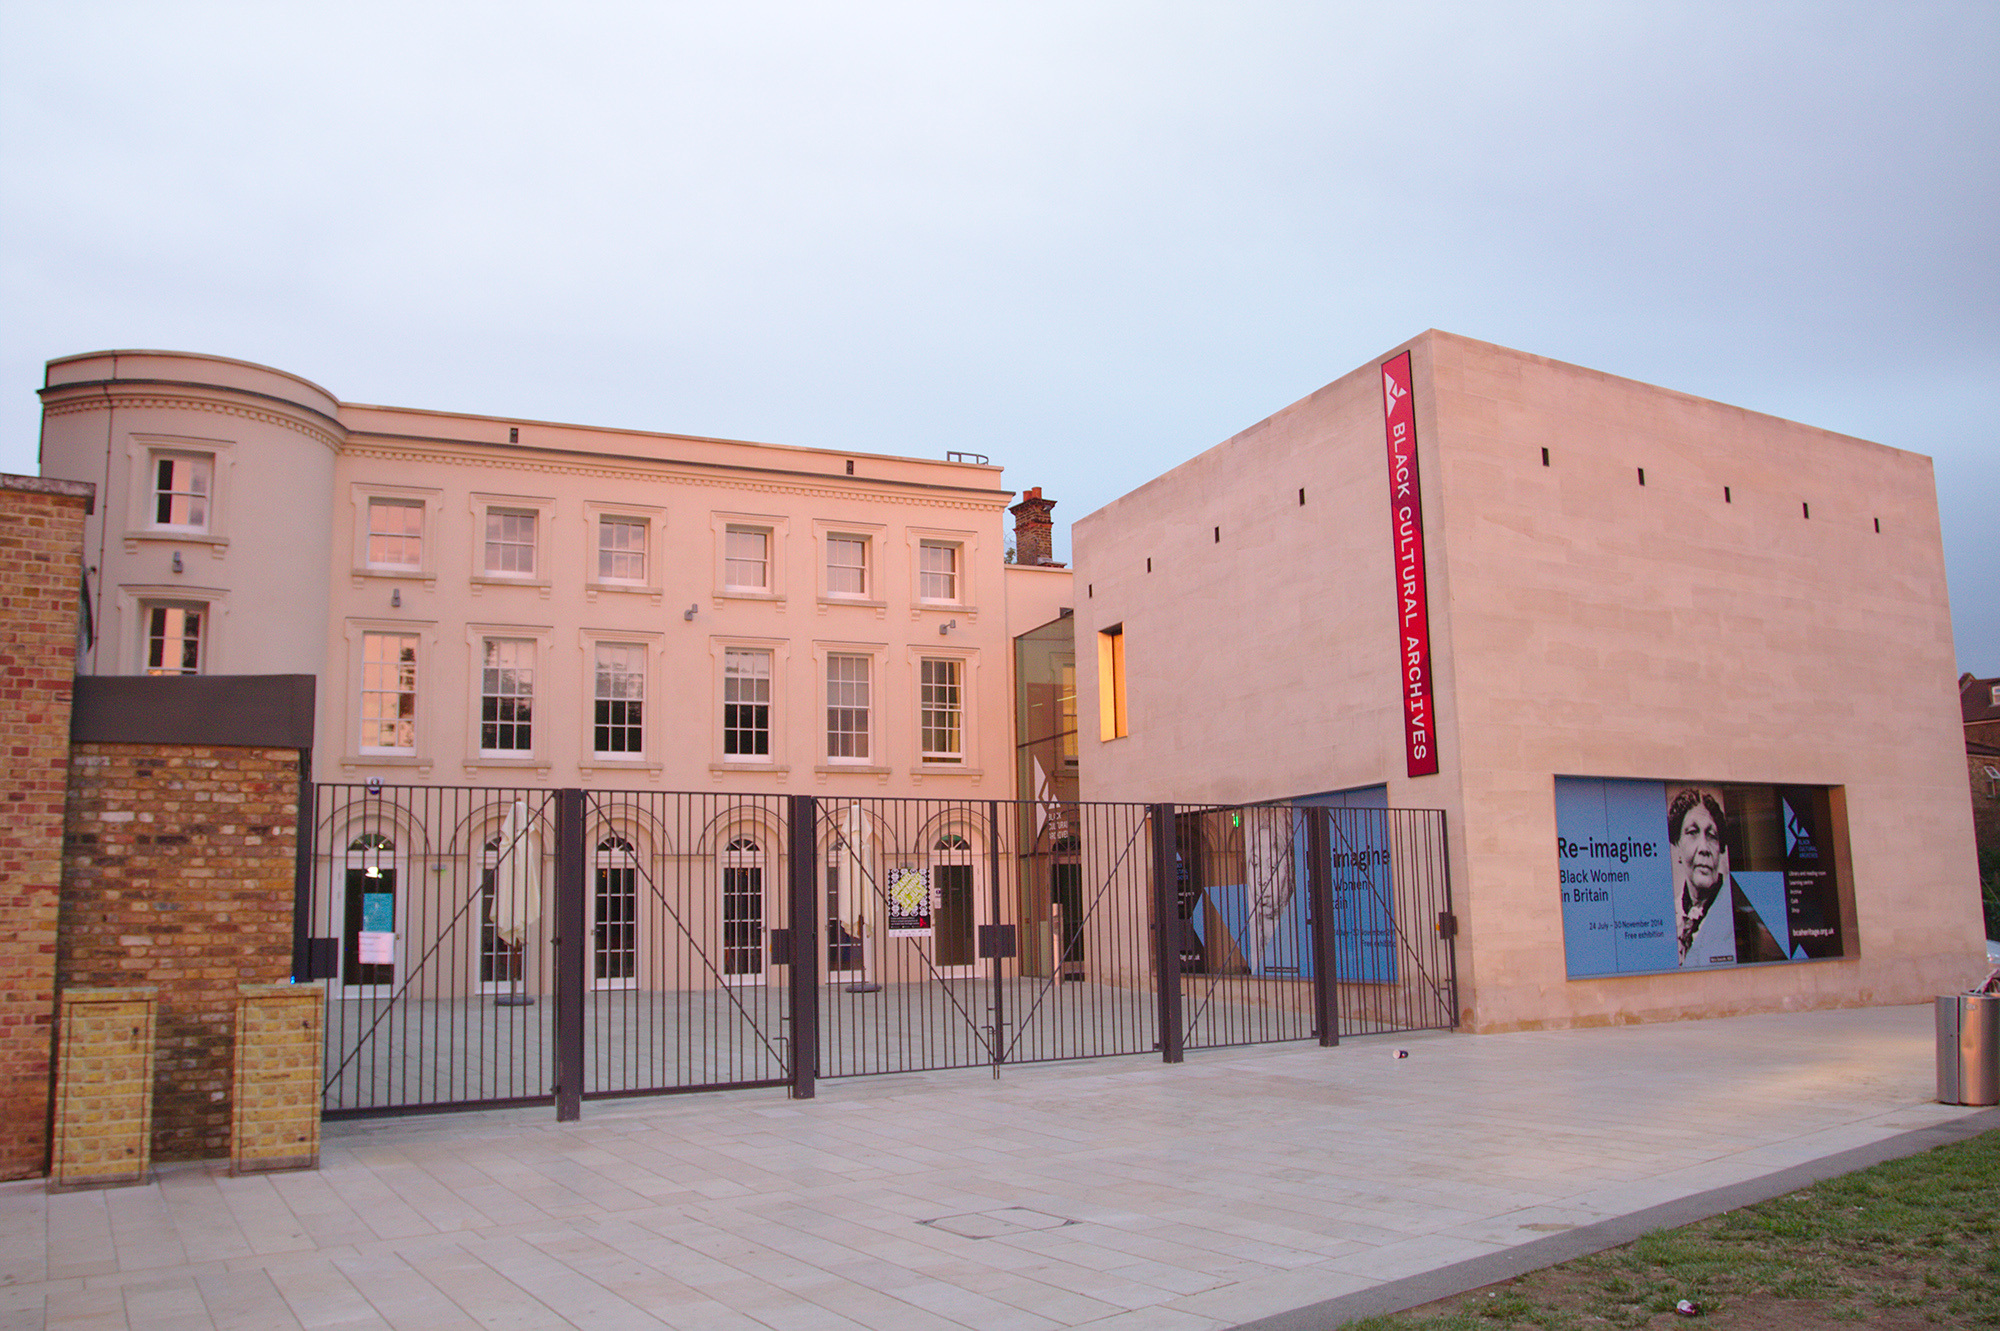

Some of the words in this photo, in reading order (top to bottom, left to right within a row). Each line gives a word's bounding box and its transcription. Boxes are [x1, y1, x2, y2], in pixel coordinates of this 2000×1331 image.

[1393, 421, 1411, 499] BLACK
[1399, 506, 1418, 627] CULTURAL
[1407, 636, 1427, 760] ARCHIVES
[1557, 836, 1658, 863] Re-imagine:
[1559, 869, 1588, 883] Black
[1590, 869, 1629, 882] Women
[1573, 888, 1609, 902] Britain
[1622, 920, 1650, 928] November
